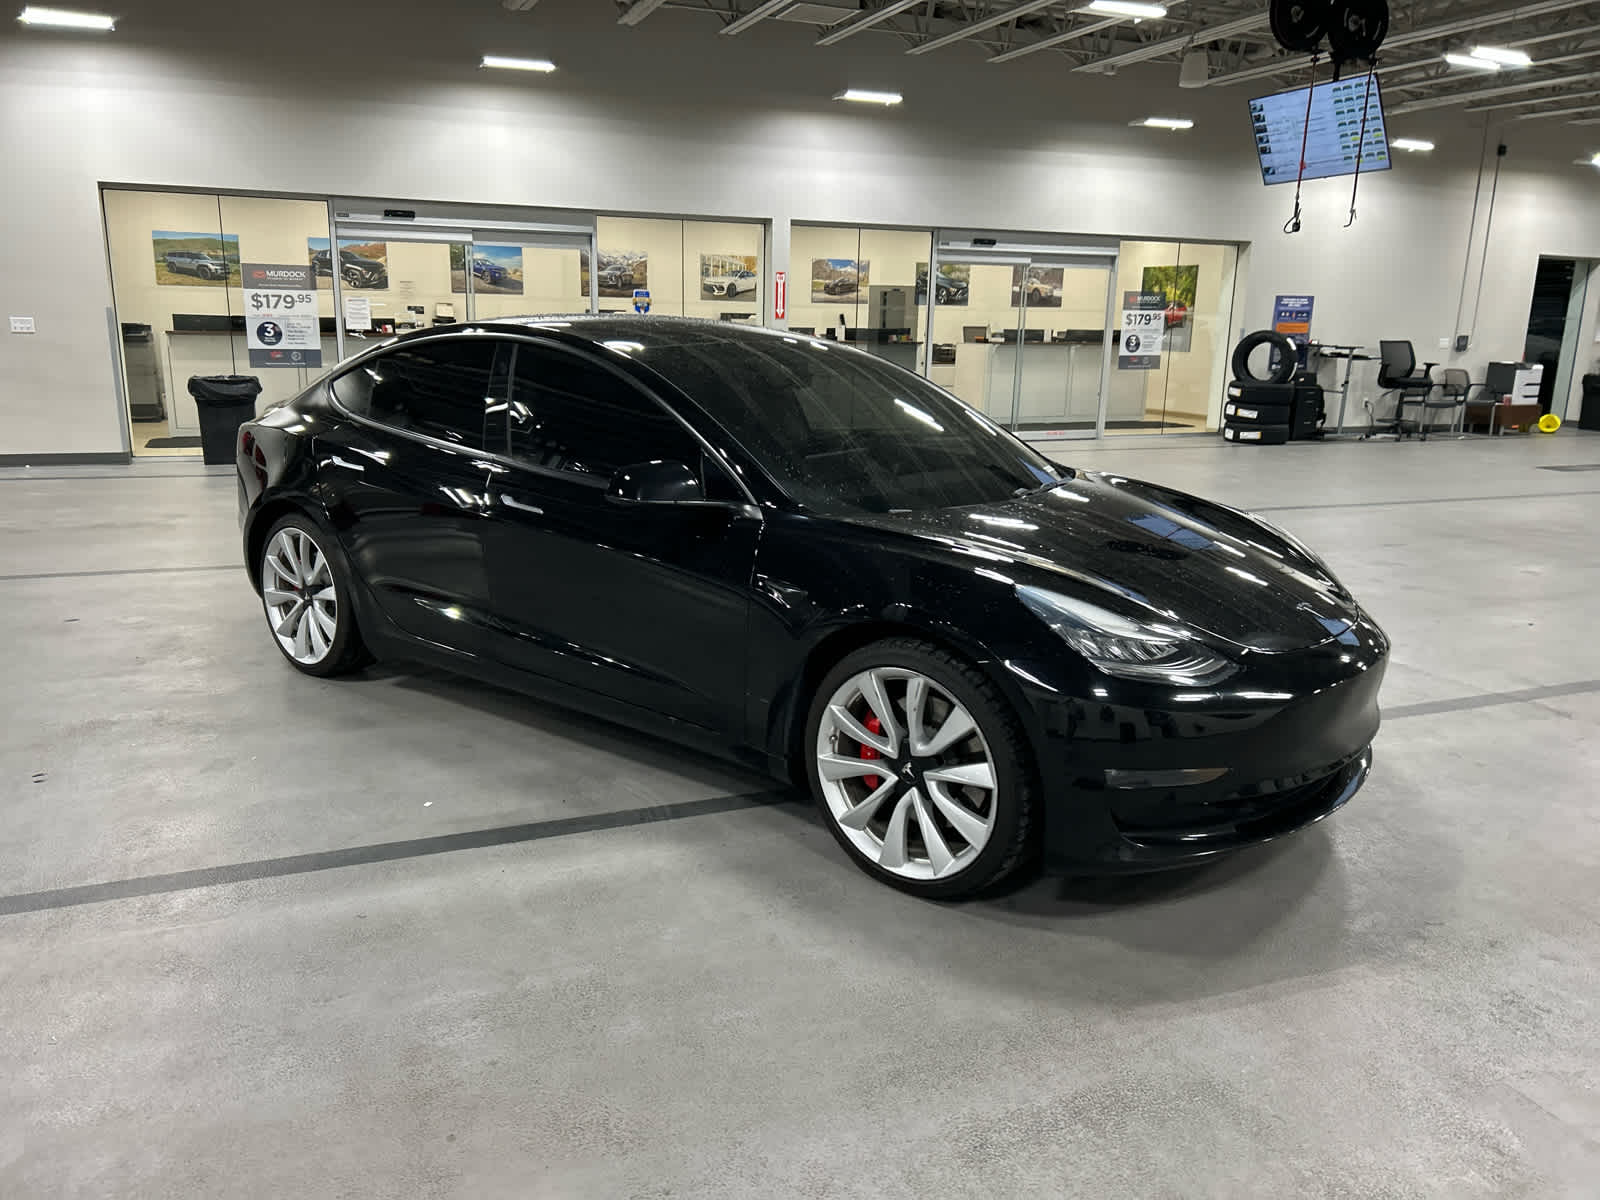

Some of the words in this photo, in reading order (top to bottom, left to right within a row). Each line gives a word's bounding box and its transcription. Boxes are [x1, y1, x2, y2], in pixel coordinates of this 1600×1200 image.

[266, 270, 306, 278] MURDOCK
[251, 292, 312, 311] $179.95
[264, 323, 274, 336] 3
